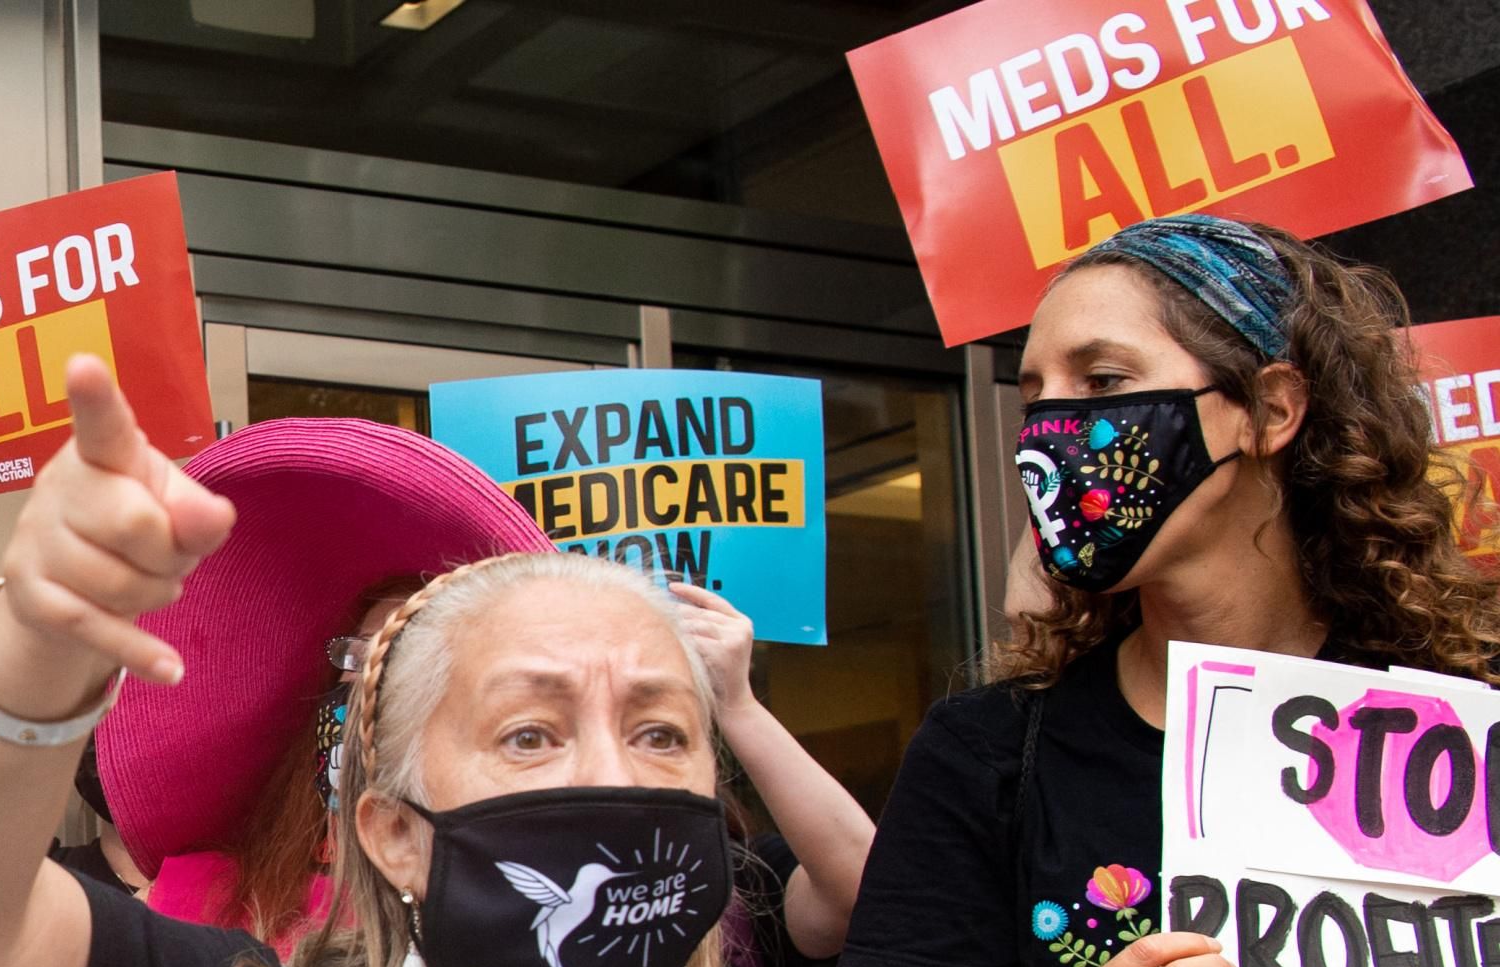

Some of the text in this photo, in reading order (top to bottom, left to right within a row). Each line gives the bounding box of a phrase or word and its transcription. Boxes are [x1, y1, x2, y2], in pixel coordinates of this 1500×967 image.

[928, 12, 1161, 160] MEDS
[1054, 75, 1300, 250] ALL.
[16, 222, 140, 316] FOR
[515, 396, 754, 476] EXPAND
[1272, 695, 1500, 854] STO
[601, 891, 686, 926] HOME
[606, 872, 686, 903] we are
